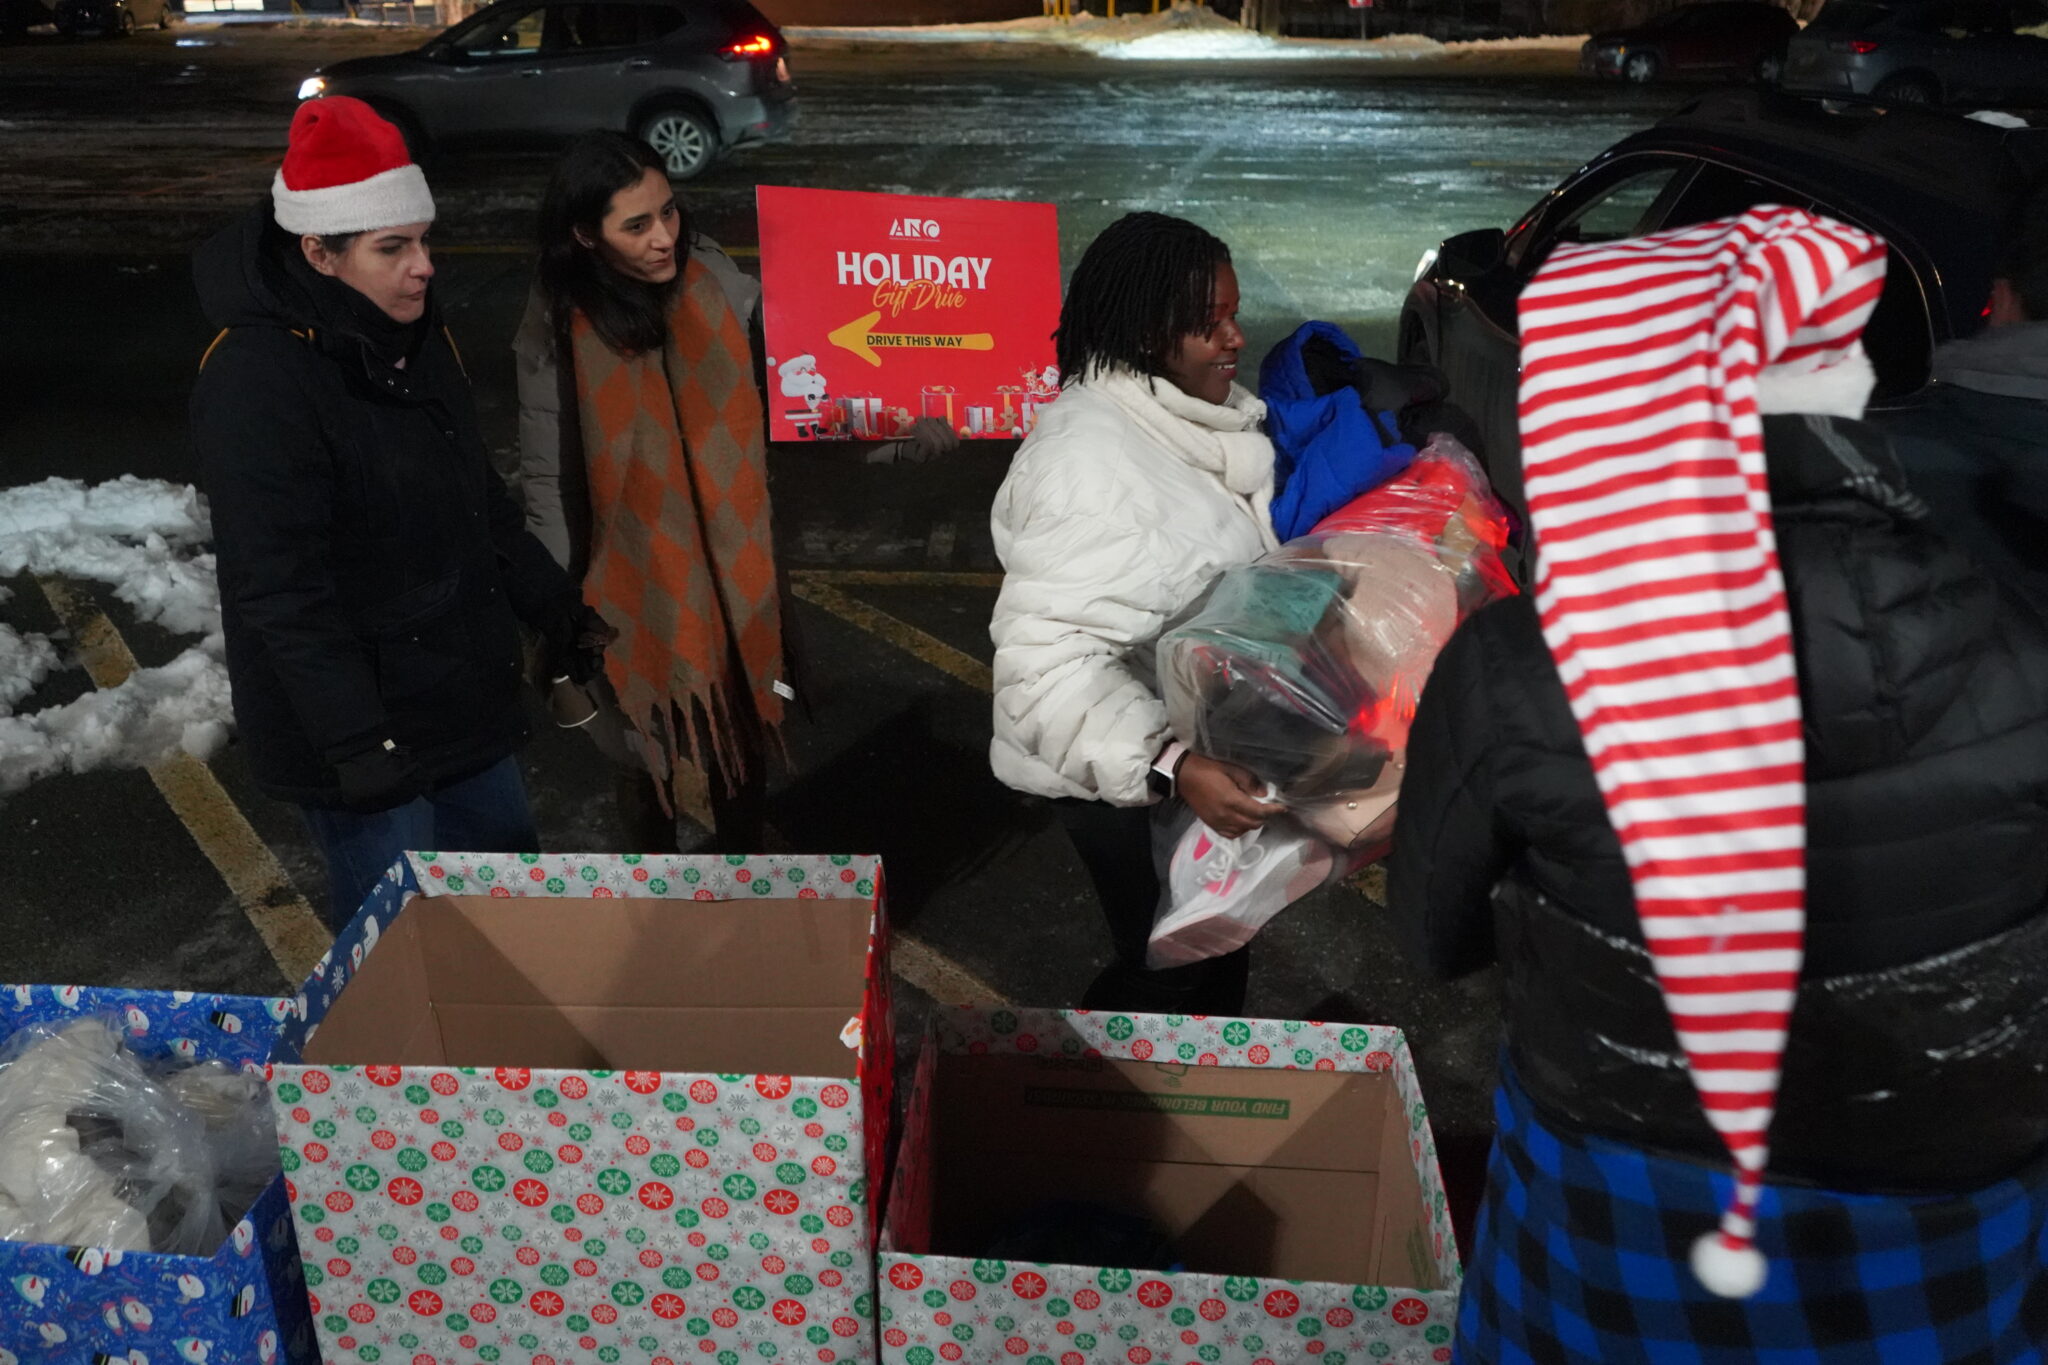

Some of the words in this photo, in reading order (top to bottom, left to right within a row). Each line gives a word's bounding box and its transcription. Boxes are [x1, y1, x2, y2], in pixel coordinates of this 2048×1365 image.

[836, 251, 992, 289] HOLIDAY
[872, 279, 914, 318] Gift
[911, 279, 966, 310] Drive
[866, 335, 902, 347] DRIVE
[905, 335, 931, 347] THIS
[933, 336, 963, 348] WAY
[1211, 1099, 1248, 1114] YOUR
[1252, 1101, 1286, 1115] FIND
